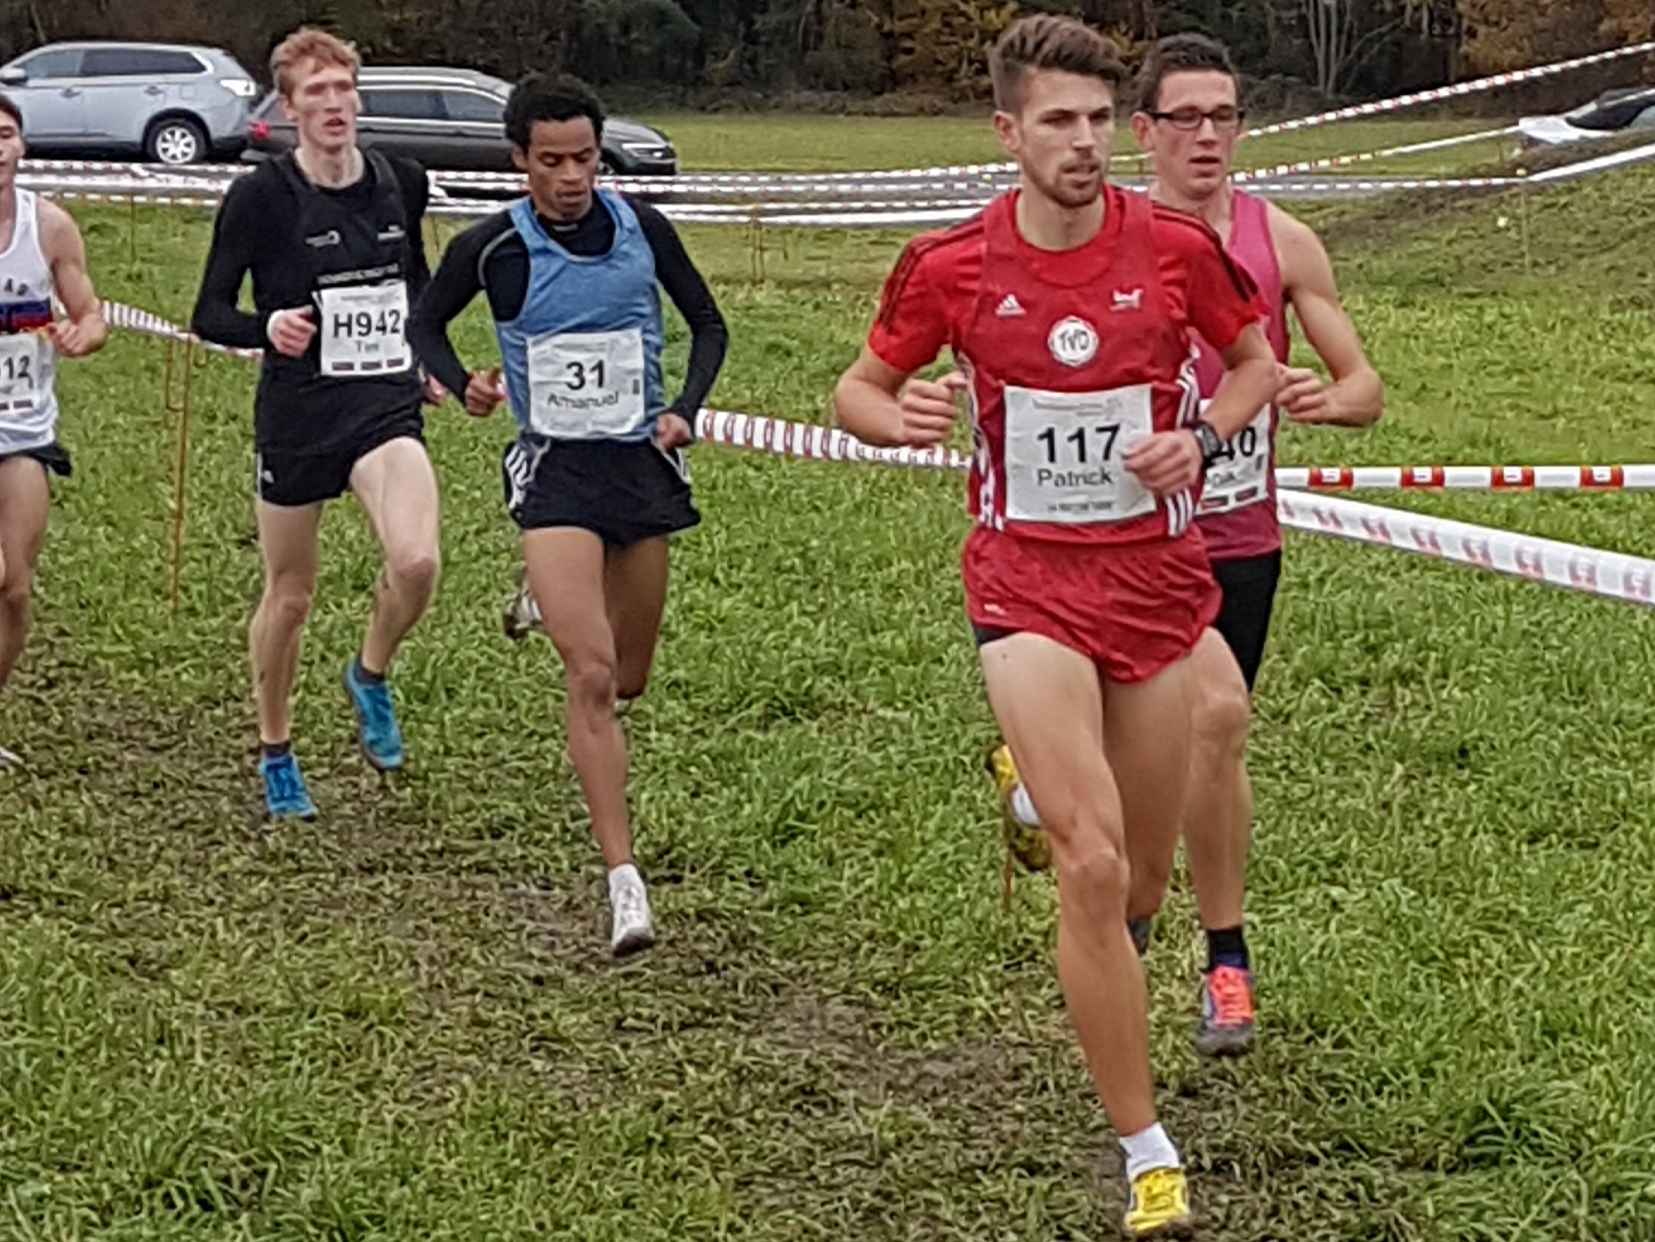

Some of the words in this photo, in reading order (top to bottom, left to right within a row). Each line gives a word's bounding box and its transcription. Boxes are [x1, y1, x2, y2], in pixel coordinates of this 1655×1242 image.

[332, 309, 401, 338] H942
[0, 355, 30, 379] 12
[566, 359, 605, 390] 31
[547, 391, 619, 410] Amanuel
[1036, 423, 1120, 463] 117
[1037, 467, 1114, 488] Patrick
